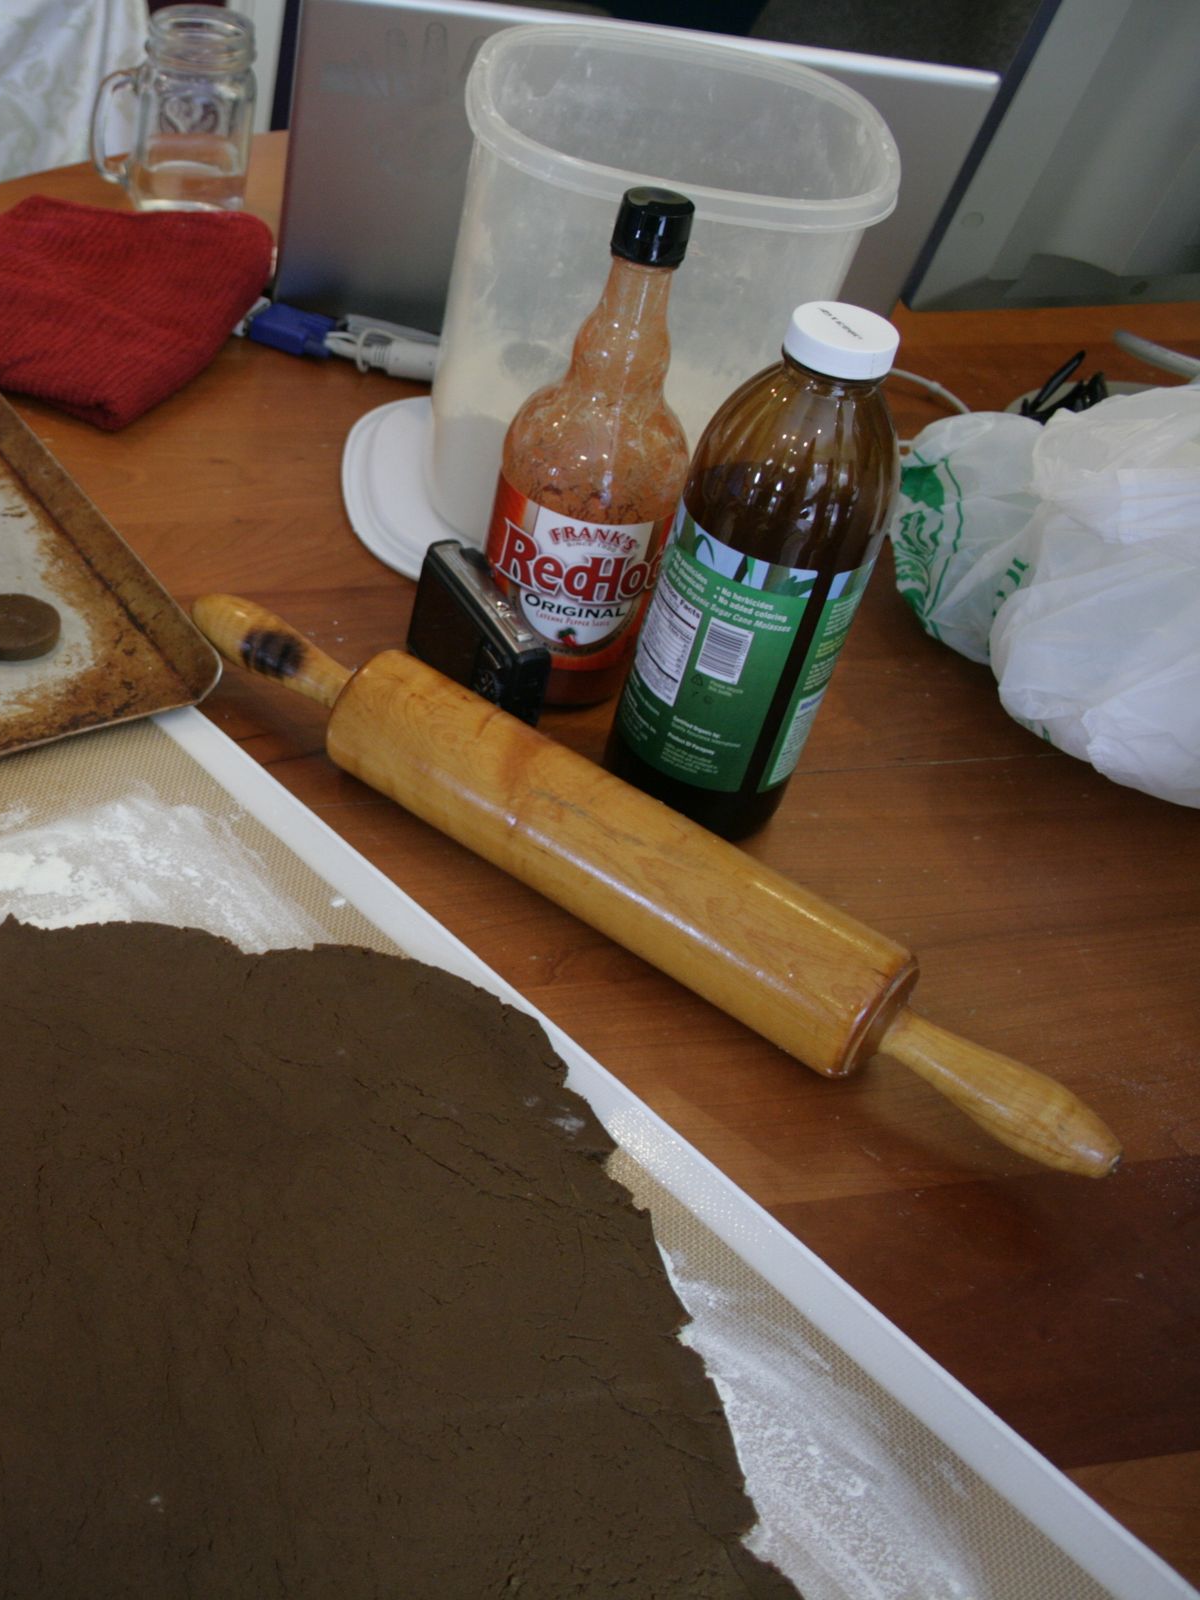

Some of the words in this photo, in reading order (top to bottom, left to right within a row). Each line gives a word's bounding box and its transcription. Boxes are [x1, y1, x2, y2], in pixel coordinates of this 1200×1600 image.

[550, 526, 638, 554] FRANK'S
[525, 593, 625, 619] ORIGINAL
[680, 598, 700, 620] Facts
[718, 595, 729, 606] No
[729, 601, 754, 615] added
[754, 610, 788, 623] coloring
[721, 587, 732, 598] No
[732, 592, 775, 611] herbicides
[732, 613, 753, 626] Cane
